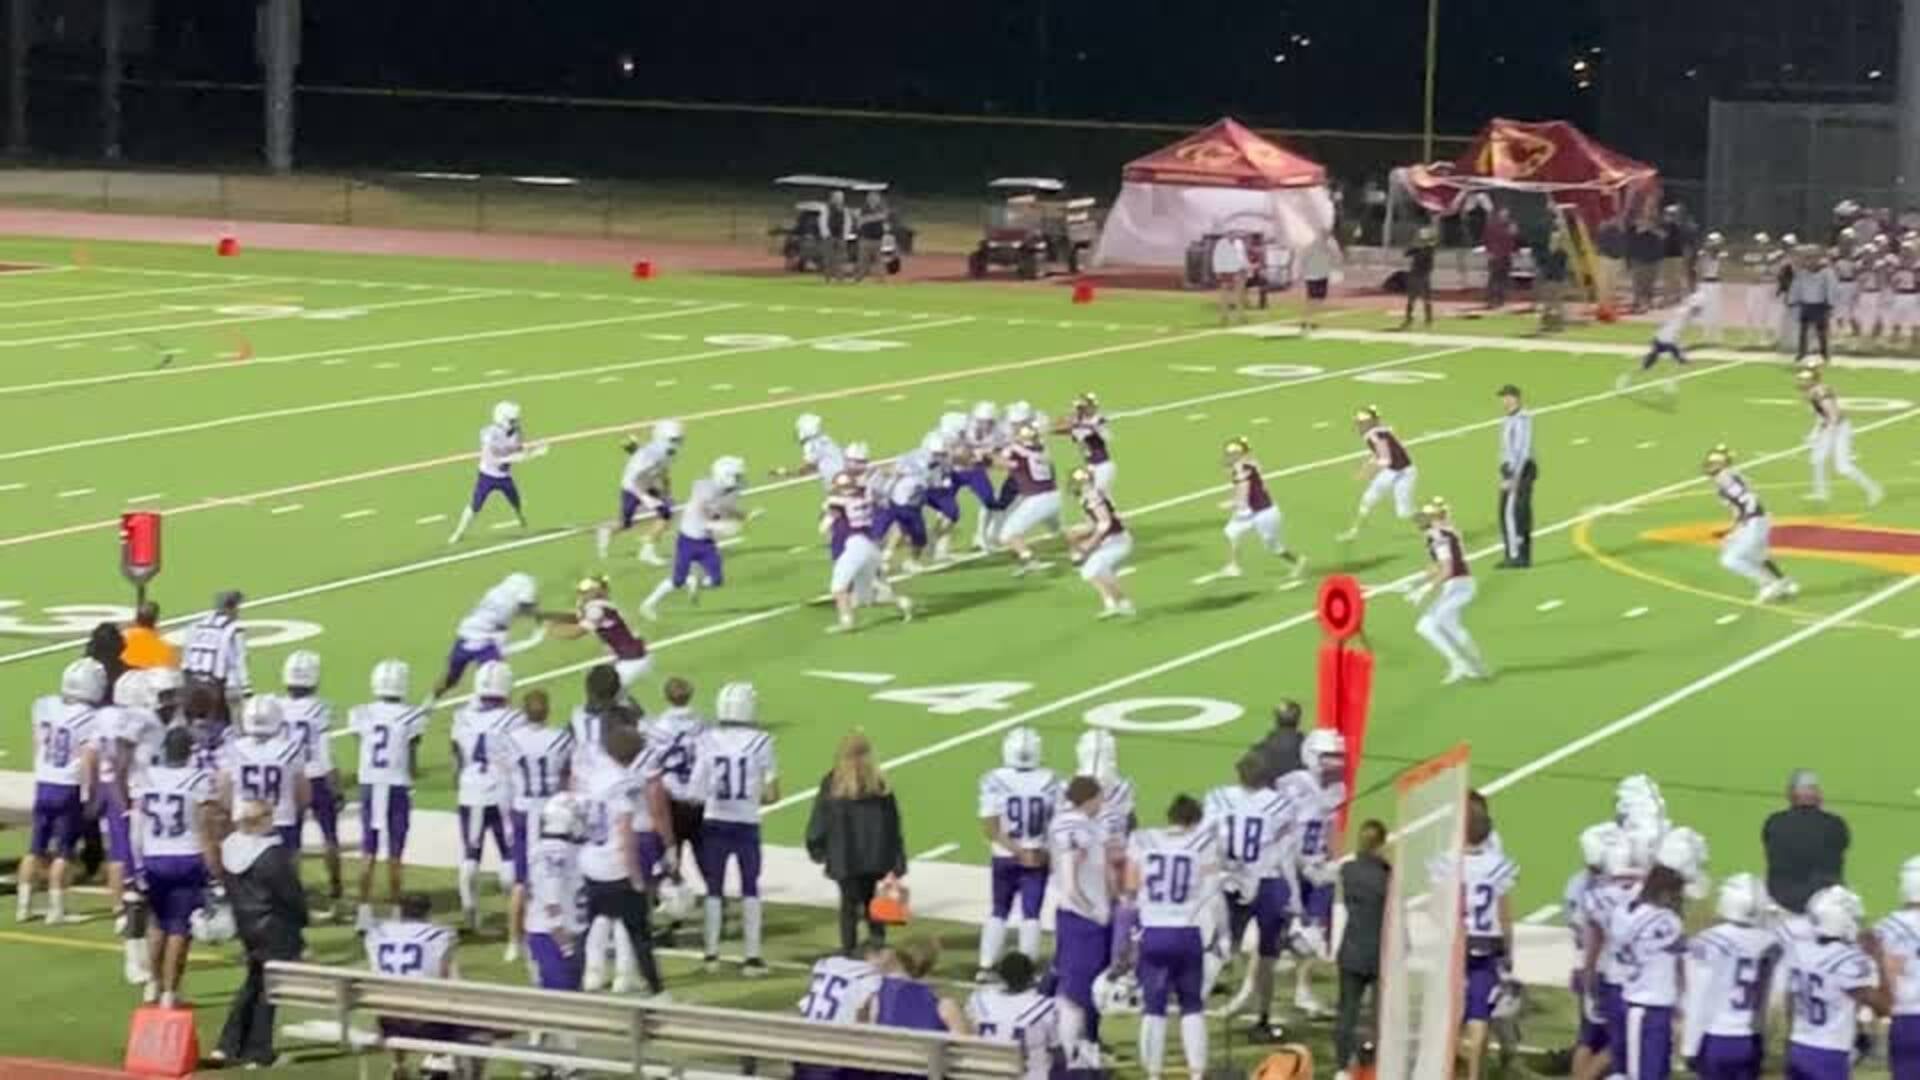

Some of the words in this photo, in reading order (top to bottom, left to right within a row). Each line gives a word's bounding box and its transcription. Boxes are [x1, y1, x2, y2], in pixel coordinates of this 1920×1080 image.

[371, 725, 390, 769] 2
[472, 732, 488, 773] 4
[242, 765, 282, 804] 58
[518, 756, 552, 797] 11
[714, 756, 748, 800] 31
[143, 793, 186, 837] 53
[1007, 796, 1044, 840] 90
[1226, 815, 1263, 862] 18
[1146, 854, 1192, 904] 20
